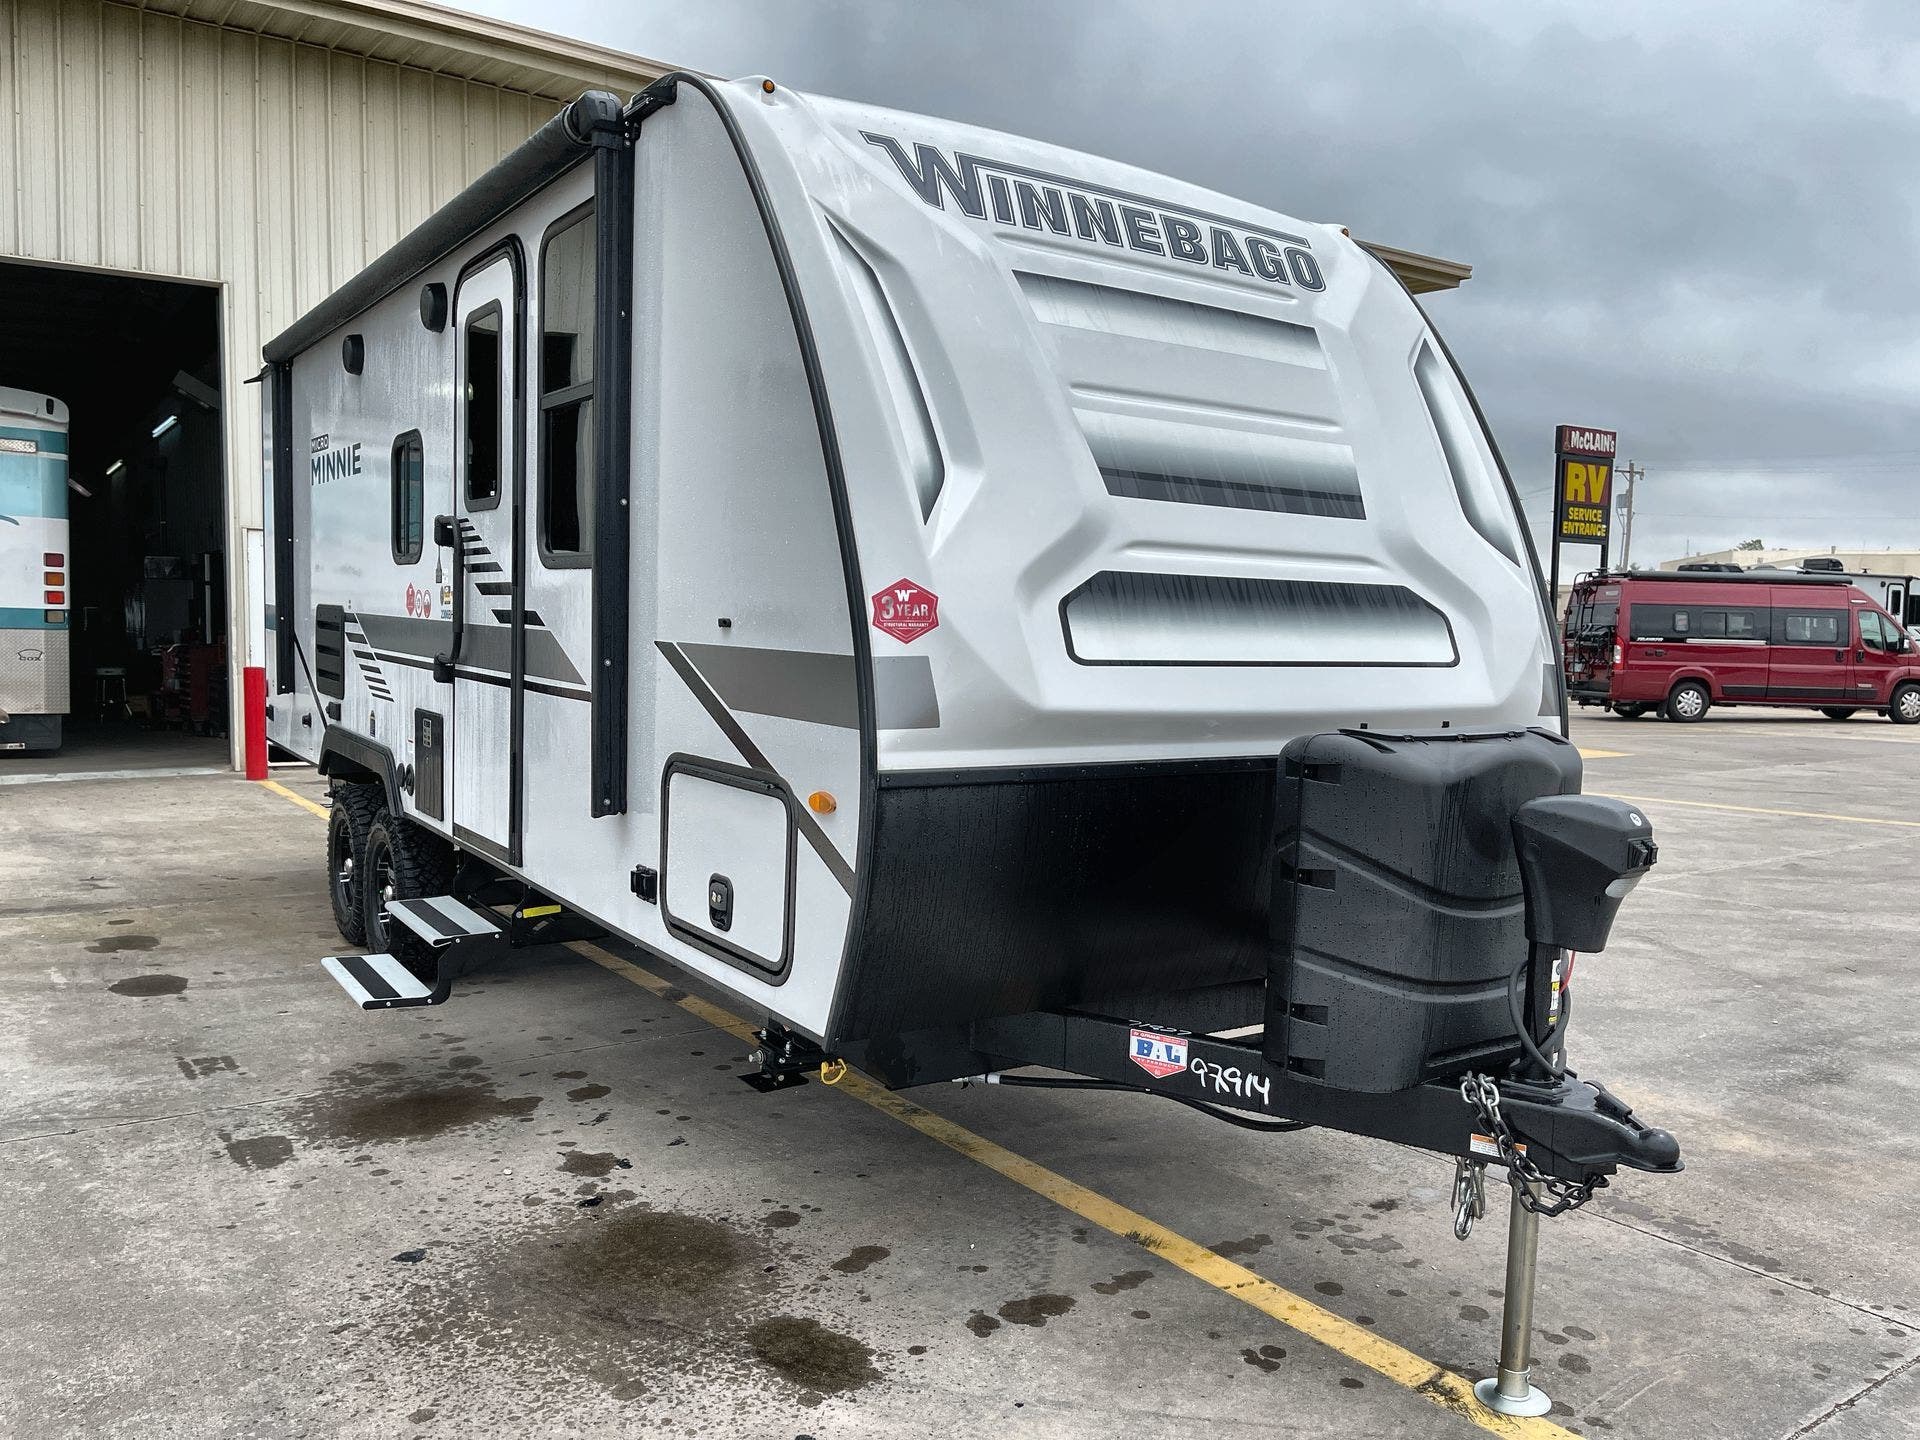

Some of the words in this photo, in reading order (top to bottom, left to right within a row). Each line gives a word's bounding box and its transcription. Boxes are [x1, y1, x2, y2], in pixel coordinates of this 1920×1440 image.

[859, 130, 1327, 292] WINNEBAGO
[311, 442, 361, 486] MINNIE
[1566, 462, 1608, 504] RV
[1568, 507, 1602, 522] SERVICE
[1562, 521, 1607, 537] ENTRANCE
[881, 595, 895, 620] 3
[896, 603, 929, 617] YEAR
[1136, 1038, 1181, 1064] BAL
